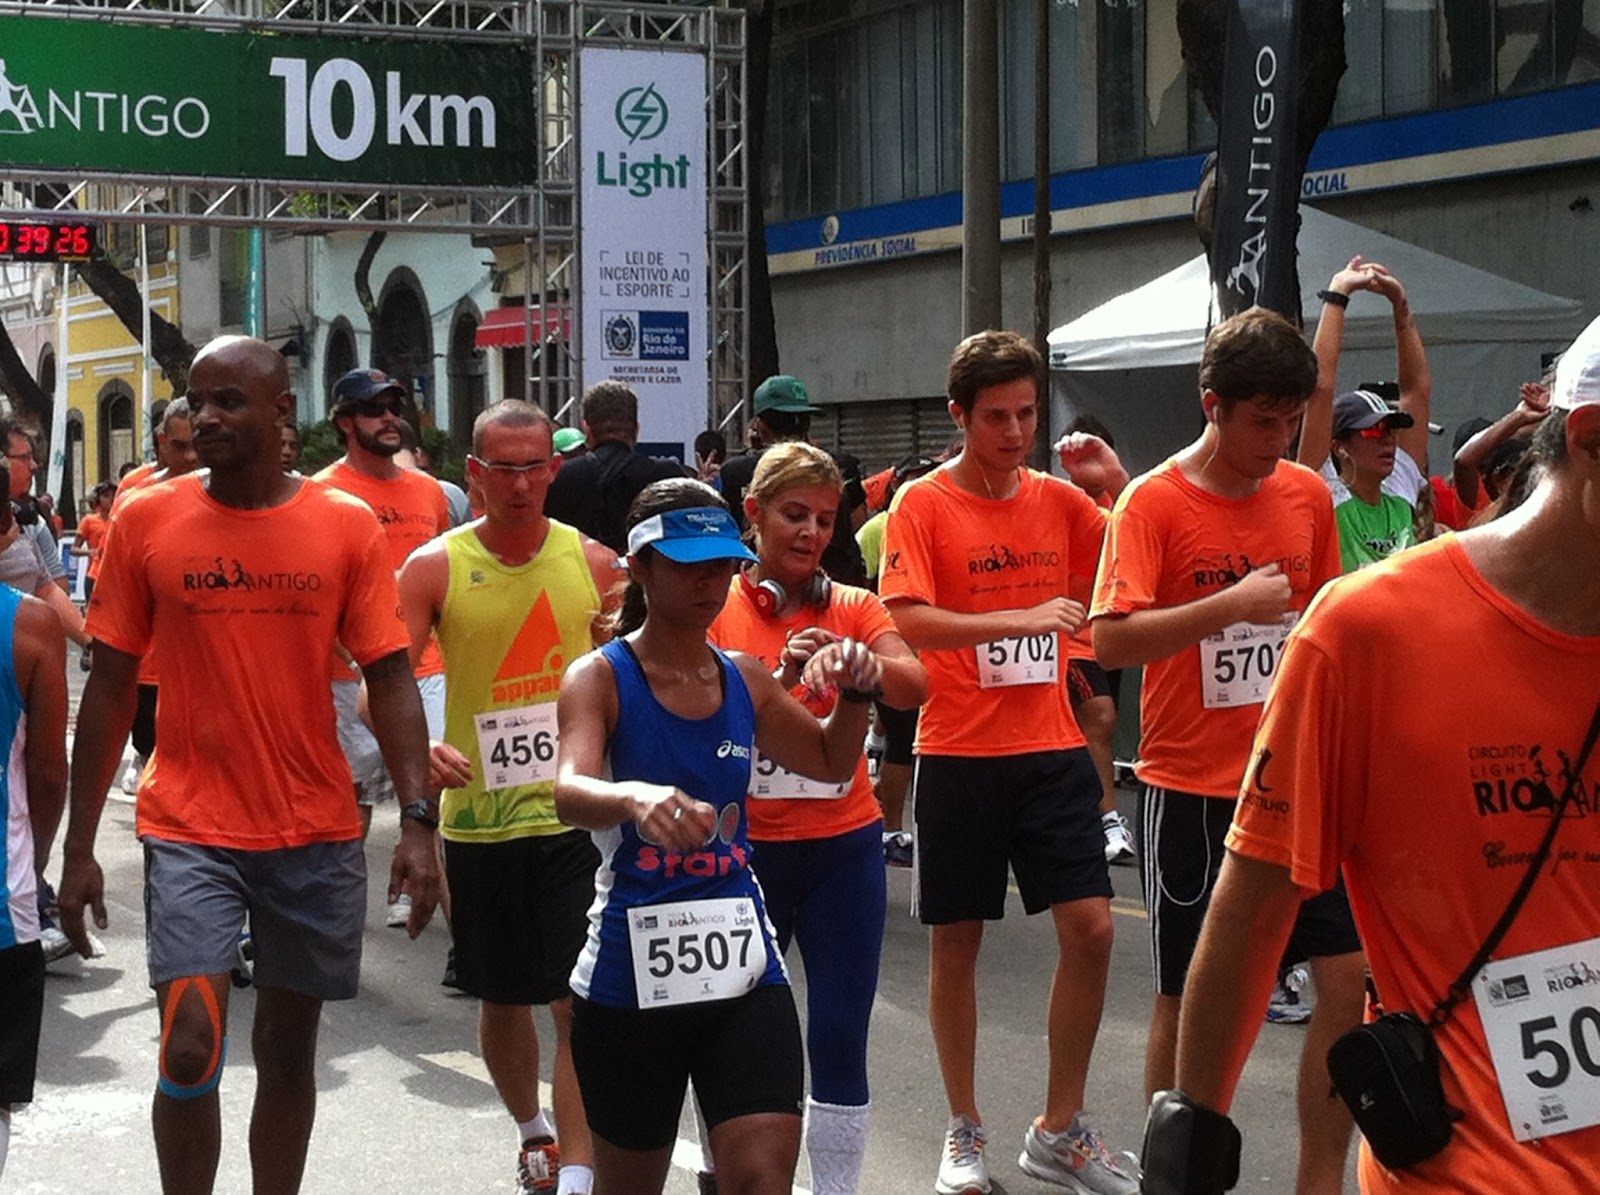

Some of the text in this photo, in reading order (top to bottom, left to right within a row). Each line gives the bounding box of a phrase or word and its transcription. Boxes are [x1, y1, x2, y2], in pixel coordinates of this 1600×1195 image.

[17, 84, 210, 139] ANTIGO
[269, 57, 497, 161] 10 km
[1242, 45, 1277, 256] ANTIGO
[597, 151, 691, 197] Light
[1302, 171, 1348, 196] OCIAL
[17, 226, 51, 253] 39
[55, 226, 88, 254] 26
[881, 237, 916, 256] SOCIAL
[625, 251, 664, 266] LEI DE
[600, 266, 690, 282] INCENTIVO AO
[616, 283, 674, 298] ESPORTE
[642, 333, 677, 344] Rio de
[642, 344, 686, 355] Janeiro
[613, 366, 678, 374] SECRETARIA DE
[655, 376, 682, 384] LAZER
[968, 559, 996, 576] RIO
[1007, 551, 1060, 569] ANTIGO
[183, 572, 321, 592] RIO ANTIGO
[1194, 569, 1230, 587] RIO
[987, 633, 1055, 666] 5702
[490, 730, 558, 768] 456
[1468, 745, 1526, 760] CIRCUITO
[1470, 763, 1526, 779] LIGHT
[1472, 777, 1535, 817] RIO
[648, 928, 754, 978] 5507
[1546, 974, 1577, 995] RIO
